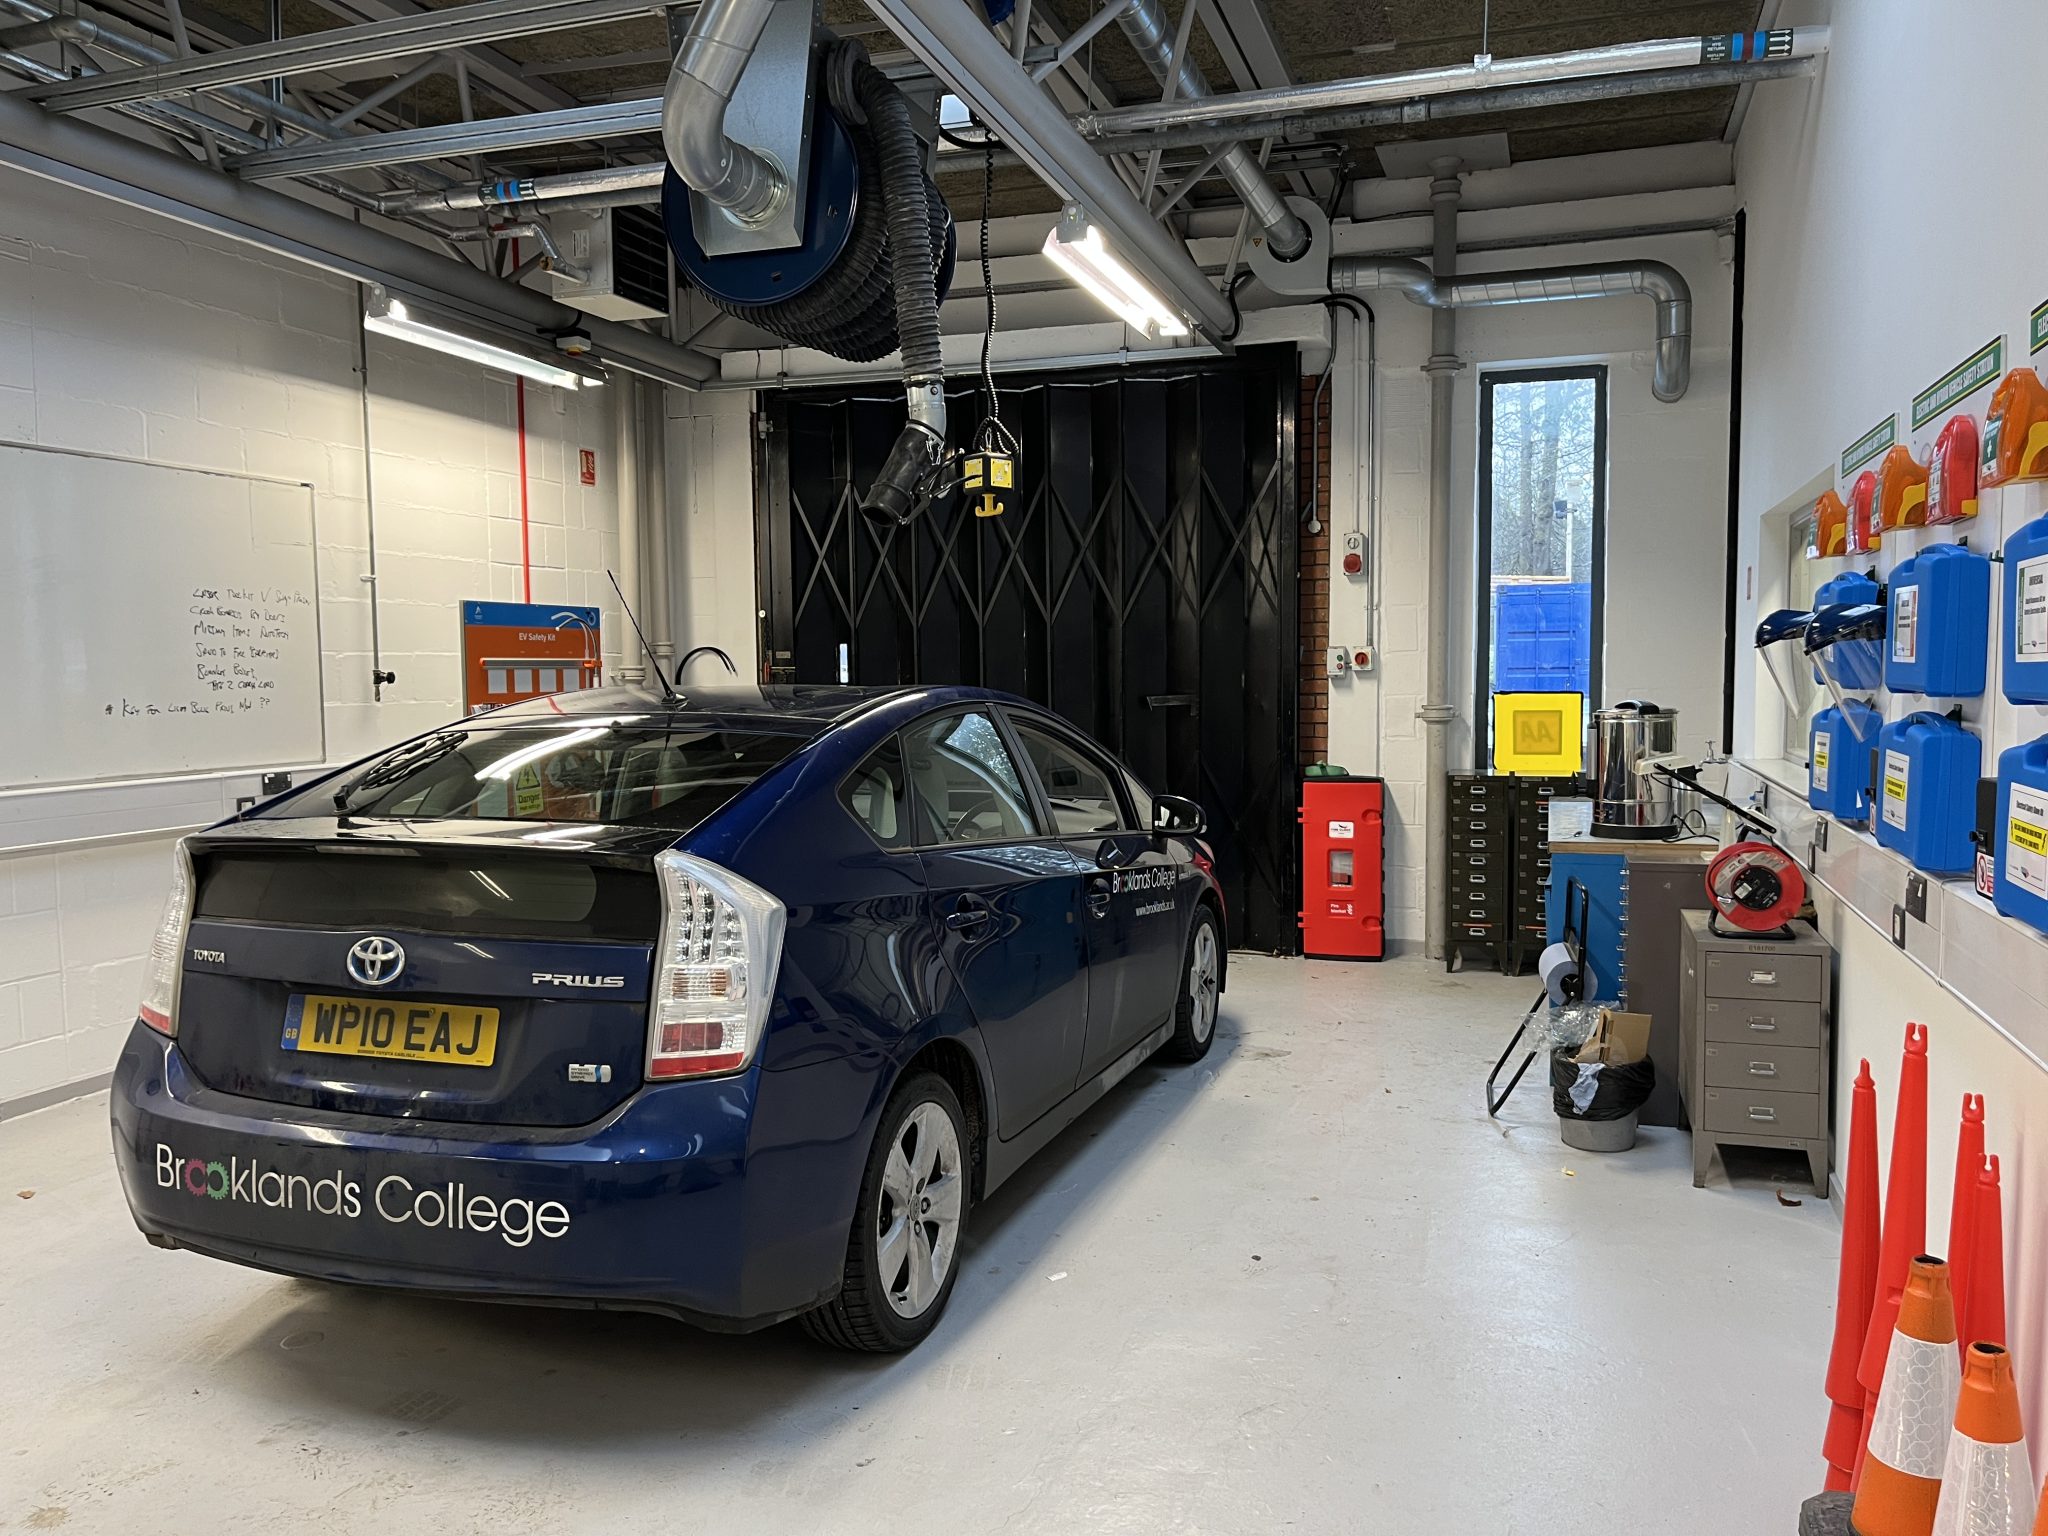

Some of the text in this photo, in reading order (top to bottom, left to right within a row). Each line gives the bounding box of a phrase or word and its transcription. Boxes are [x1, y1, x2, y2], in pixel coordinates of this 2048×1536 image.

[518, 632, 527, 641] EV
[528, 633, 546, 642] Safety
[1113, 867, 1176, 893] Brooklands College
[193, 949, 225, 963] TOYOTA
[532, 973, 625, 987] PRIUS
[285, 1028, 298, 1038] GB
[314, 1002, 483, 1056] WP10 EAJ
[156, 1143, 570, 1247] Brooklands College
